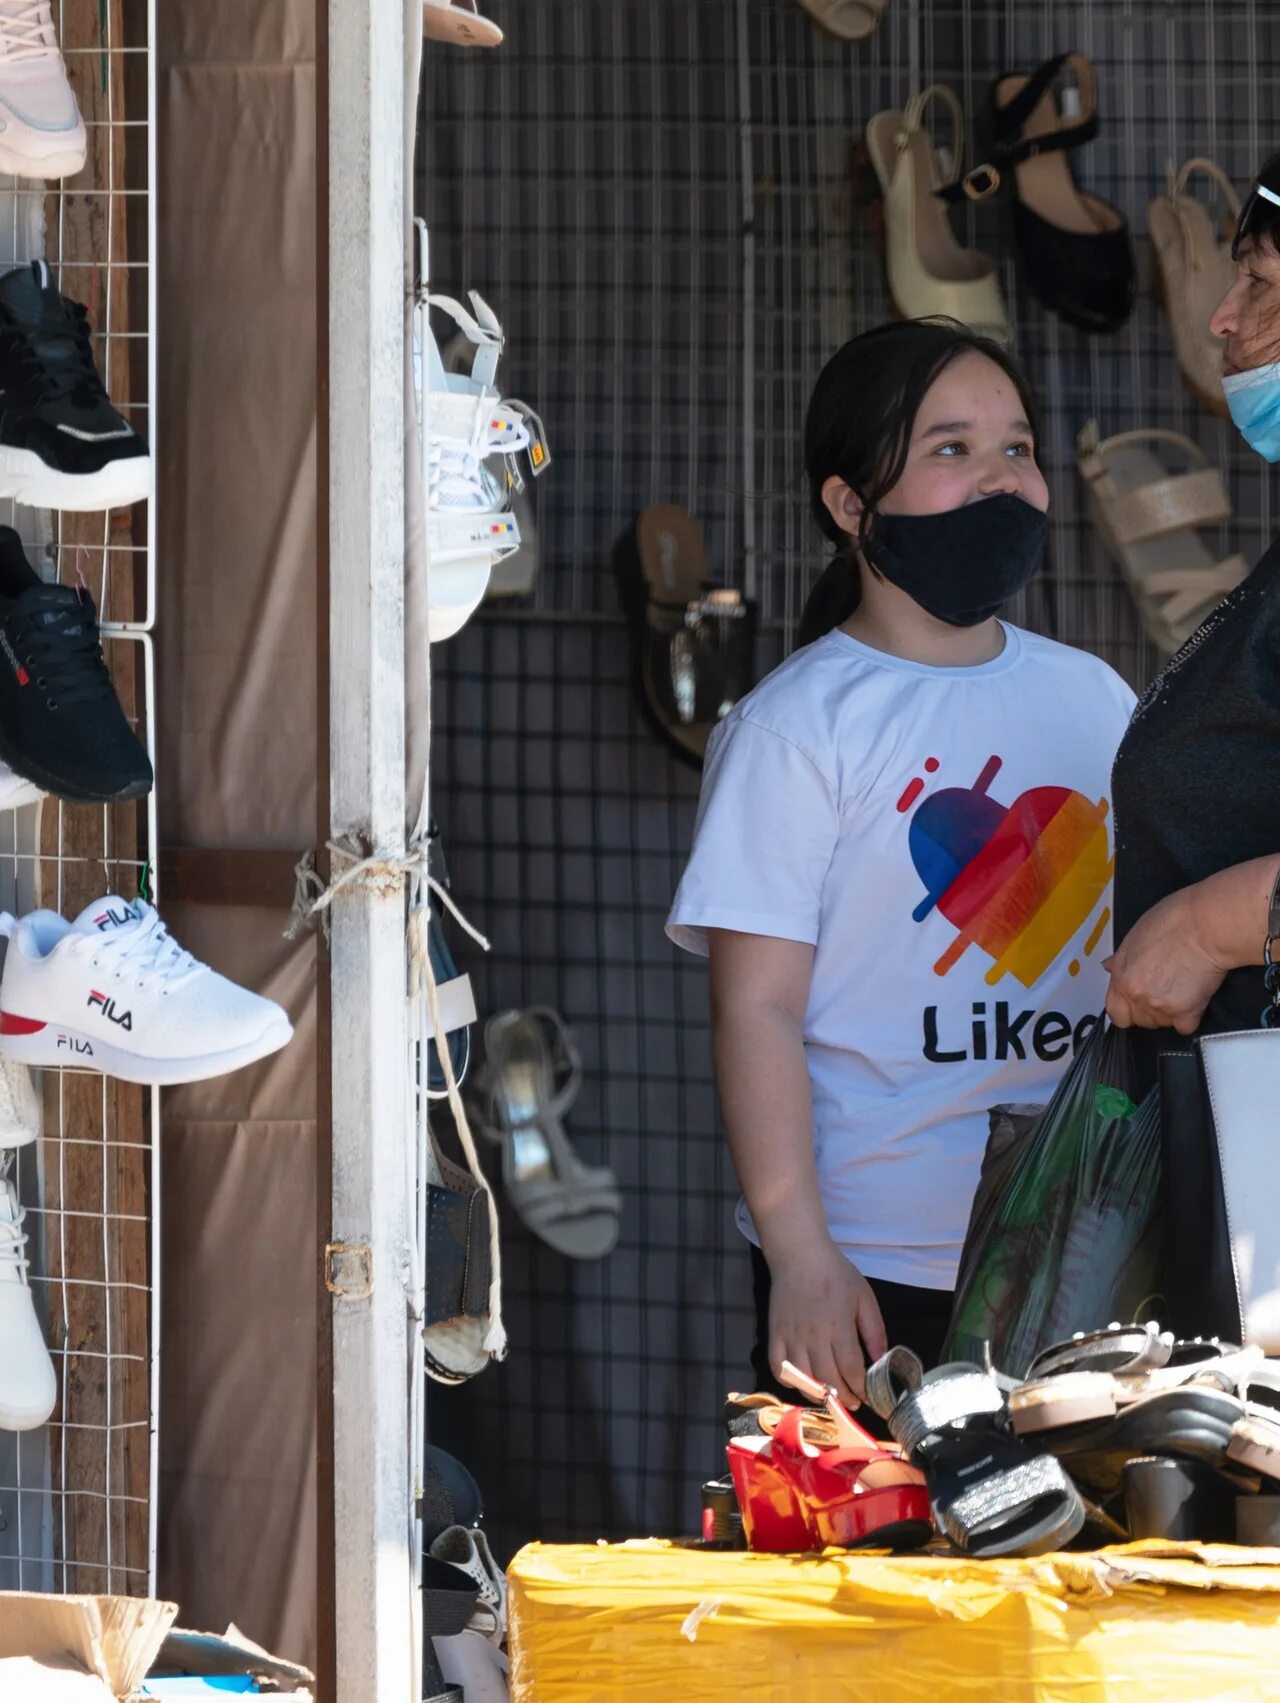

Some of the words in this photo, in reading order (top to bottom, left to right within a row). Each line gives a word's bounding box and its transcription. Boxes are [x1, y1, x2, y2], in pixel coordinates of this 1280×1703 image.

[93, 907, 138, 932] FILA
[87, 989, 133, 1032] FILA
[57, 1034, 94, 1057] FILA
